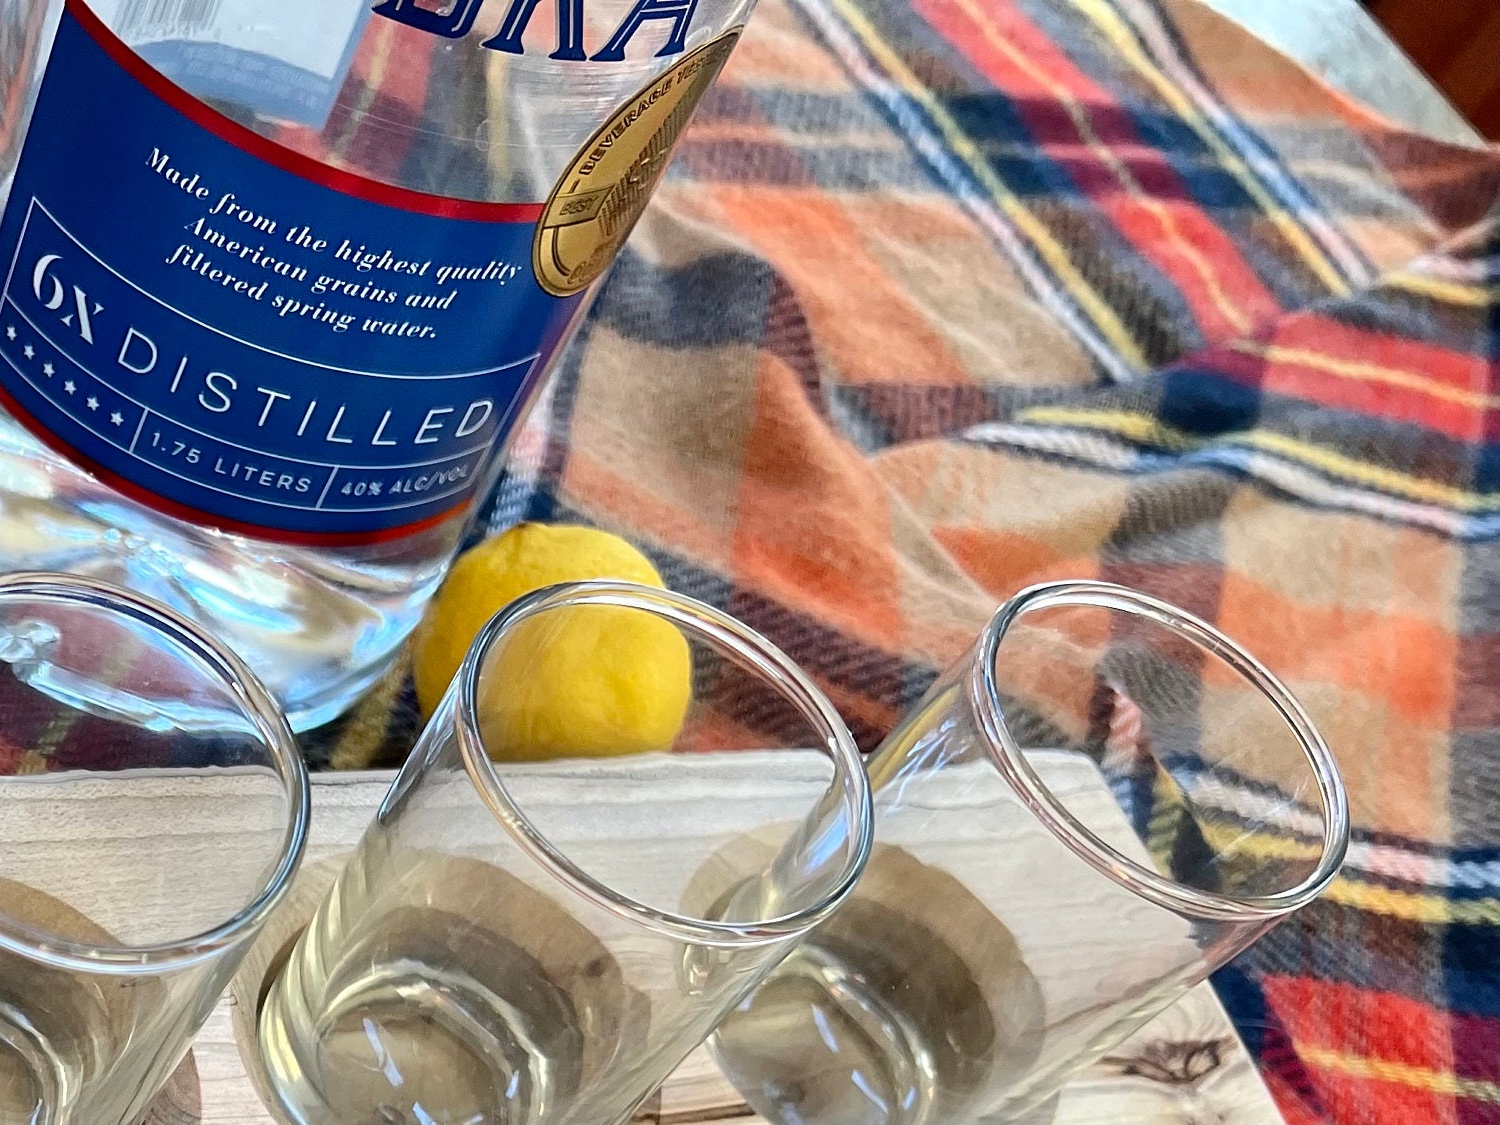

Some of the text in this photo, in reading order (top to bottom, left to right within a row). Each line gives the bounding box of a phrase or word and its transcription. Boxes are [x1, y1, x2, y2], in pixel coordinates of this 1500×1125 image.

[579, 77, 673, 175] BEVERAGE
[145, 147, 209, 200] Made
[208, 193, 277, 235] from
[285, 226, 328, 253] the
[334, 239, 431, 276] highest
[436, 261, 523, 286] quality
[183, 217, 458, 311] American grains and
[165, 244, 438, 340] filtered spring water.
[118, 327, 494, 446] DISTILLED
[152, 432, 312, 493] 1.75 LITERS
[341, 461, 470, 497] 40% ALC/VOL
